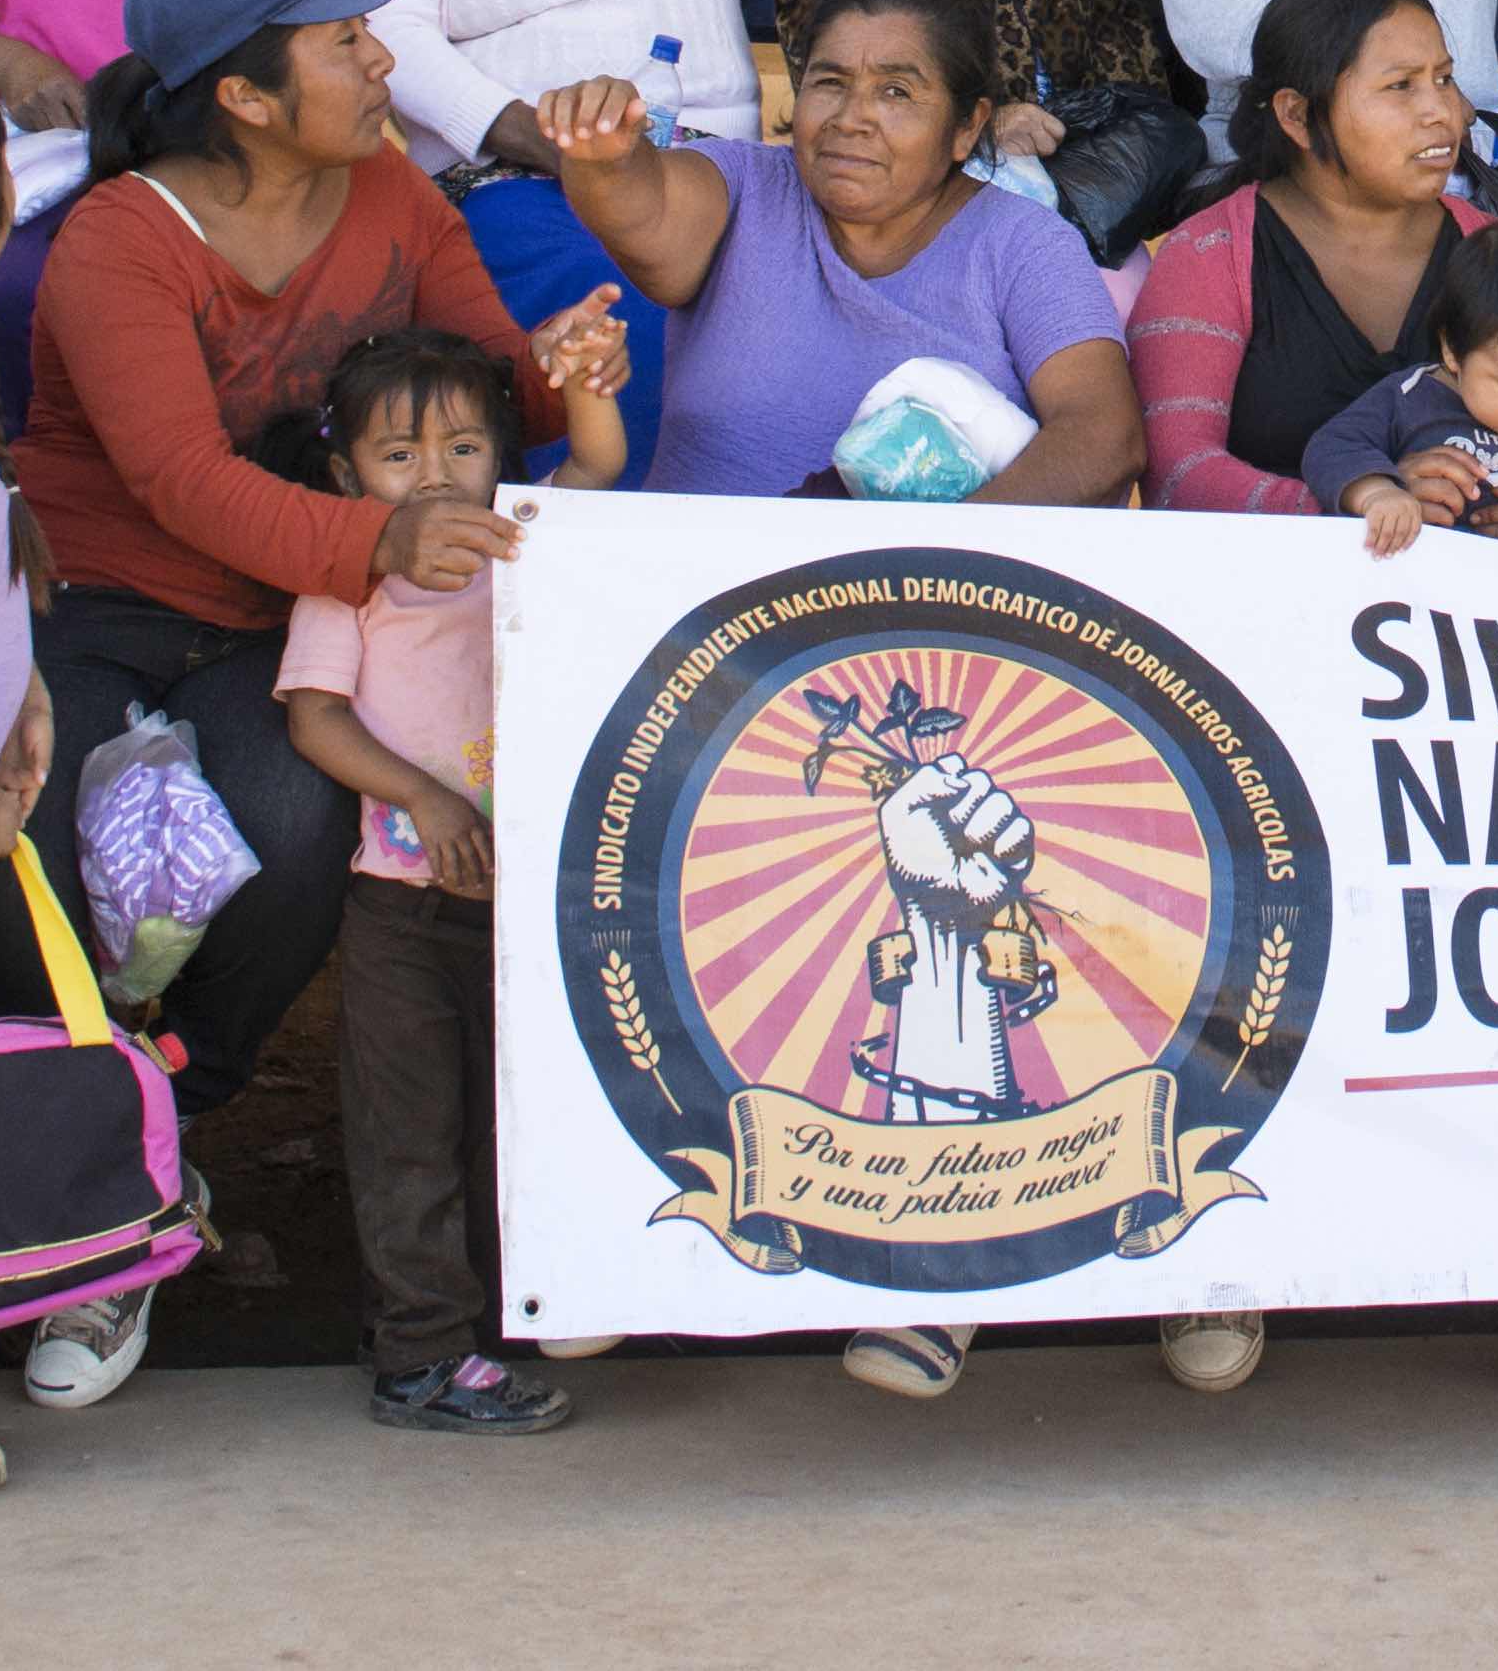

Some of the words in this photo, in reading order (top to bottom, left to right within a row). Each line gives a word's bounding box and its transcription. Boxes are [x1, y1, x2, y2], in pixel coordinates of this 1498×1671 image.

[594, 772, 643, 911] SINDICATO
[622, 606, 777, 773] INDEPENDIENTE
[771, 578, 898, 622] NACIONAL
[903, 577, 1079, 634] DEMOCRATICO
[1079, 619, 1118, 652] DE
[1111, 636, 1243, 757] JORNALEROS
[1226, 756, 1295, 882] AGRICOLAS
[864, 1153, 909, 1176] un
[908, 1142, 1027, 1187] futuro
[1037, 1112, 1124, 1164] mejor
[780, 1175, 814, 1202] y
[823, 1181, 891, 1213] una
[879, 1180, 1003, 1225] patria
